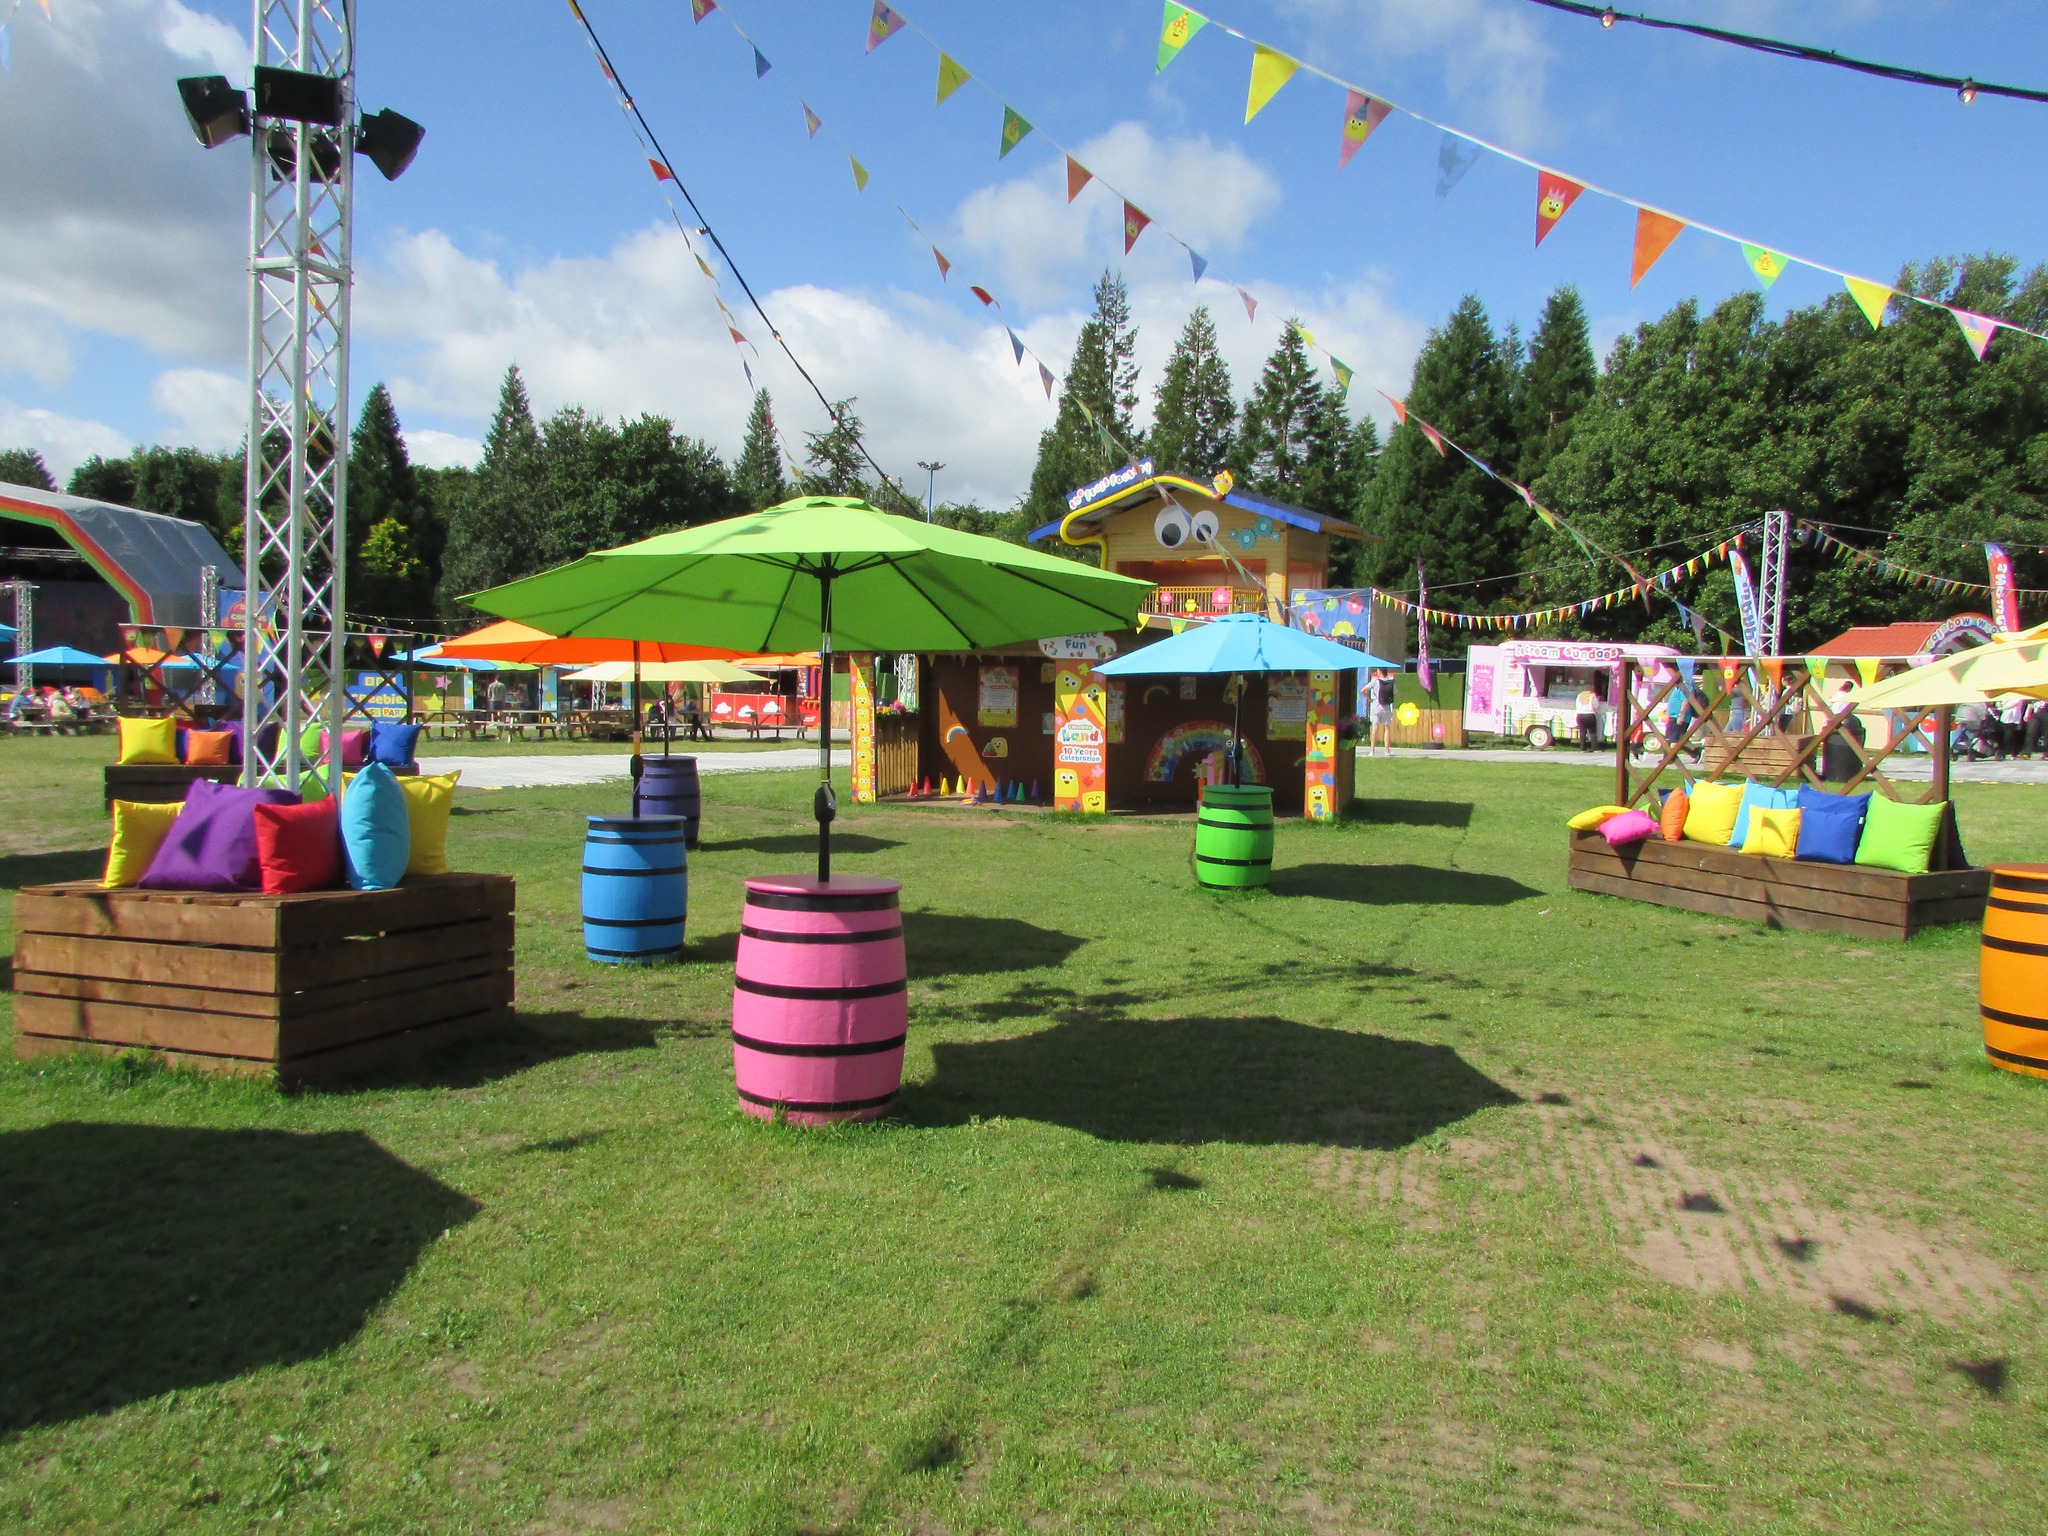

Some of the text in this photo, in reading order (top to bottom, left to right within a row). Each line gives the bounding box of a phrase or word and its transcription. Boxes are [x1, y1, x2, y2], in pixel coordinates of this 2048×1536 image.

[1069, 489, 1084, 509] the
[1085, 477, 1110, 502] fruit
[1065, 639, 1087, 649] Fun
[1565, 646, 1619, 660] sundaes
[1062, 729, 1098, 742] Land
[1060, 754, 1101, 762] Celebration
[1064, 747, 1098, 756] 10 Years
[1313, 803, 1323, 816] 2
